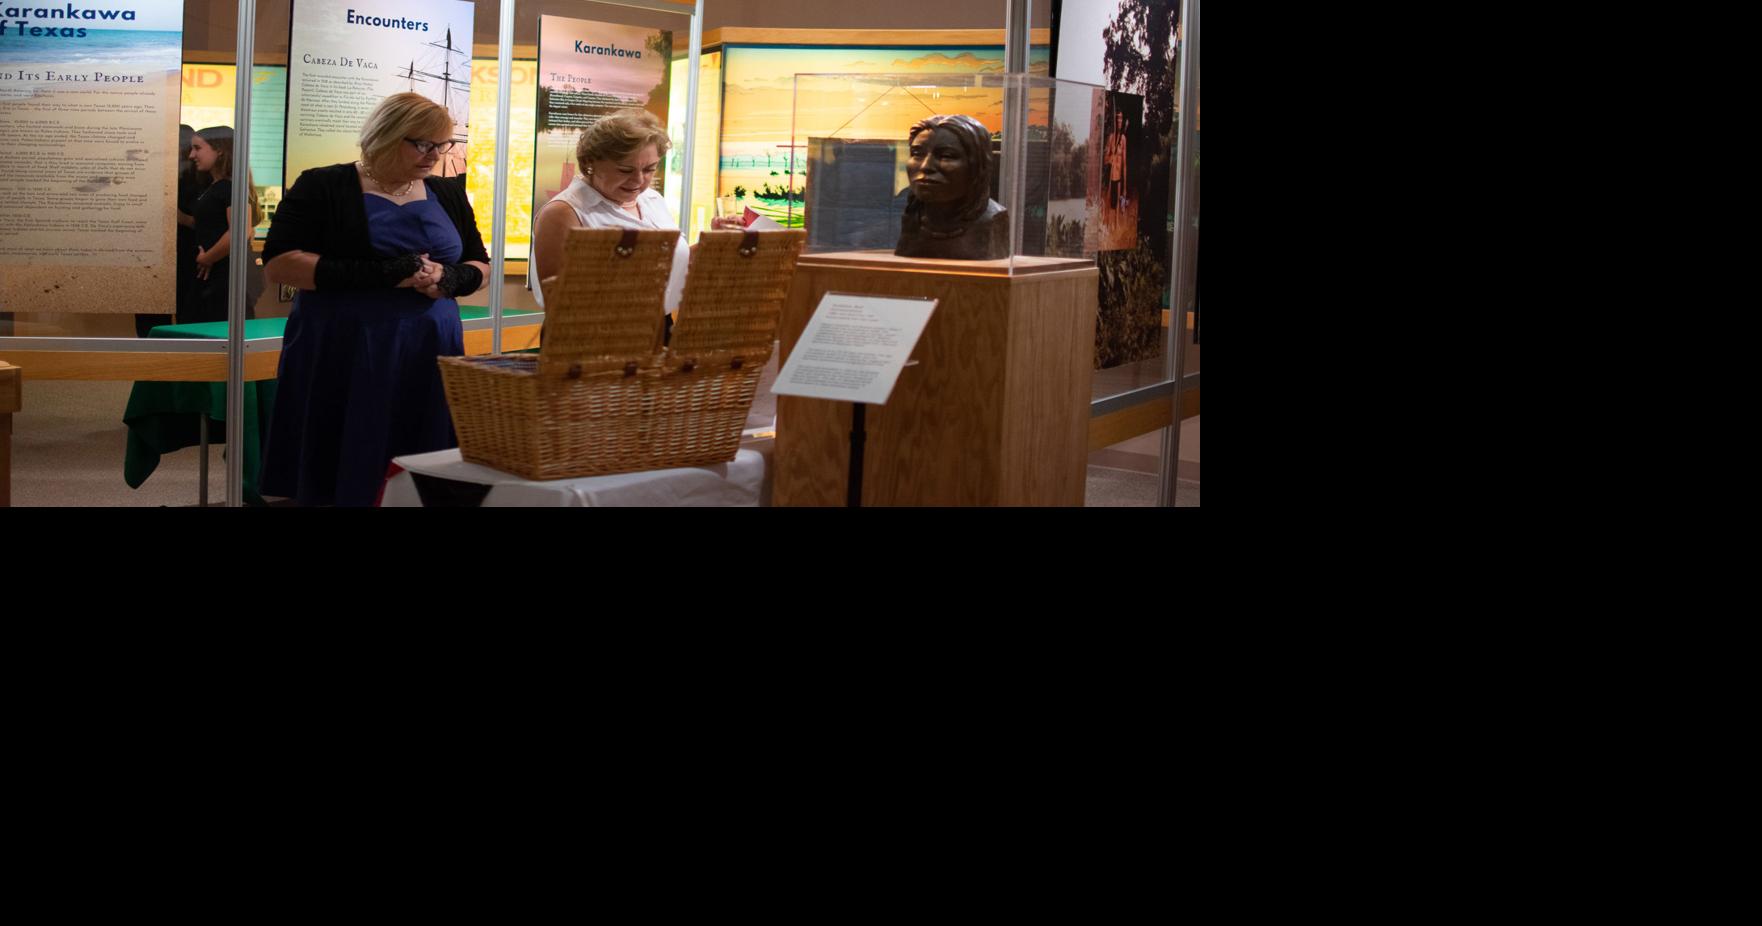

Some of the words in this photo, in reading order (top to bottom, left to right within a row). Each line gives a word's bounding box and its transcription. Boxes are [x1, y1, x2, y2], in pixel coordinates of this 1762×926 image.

[0, 2, 136, 21] arankawa
[347, 9, 429, 31] Encounters
[0, 20, 8, 35] f
[15, 21, 87, 38] Texas
[575, 40, 641, 59] Karankawa
[303, 53, 337, 66] CABEZA
[357, 58, 379, 69] VACA
[17, 70, 40, 81] ITS
[46, 71, 88, 82] EARLY
[95, 72, 144, 83] PEOPLE
[551, 72, 565, 82] THE
[567, 74, 592, 84] PEOPLE
